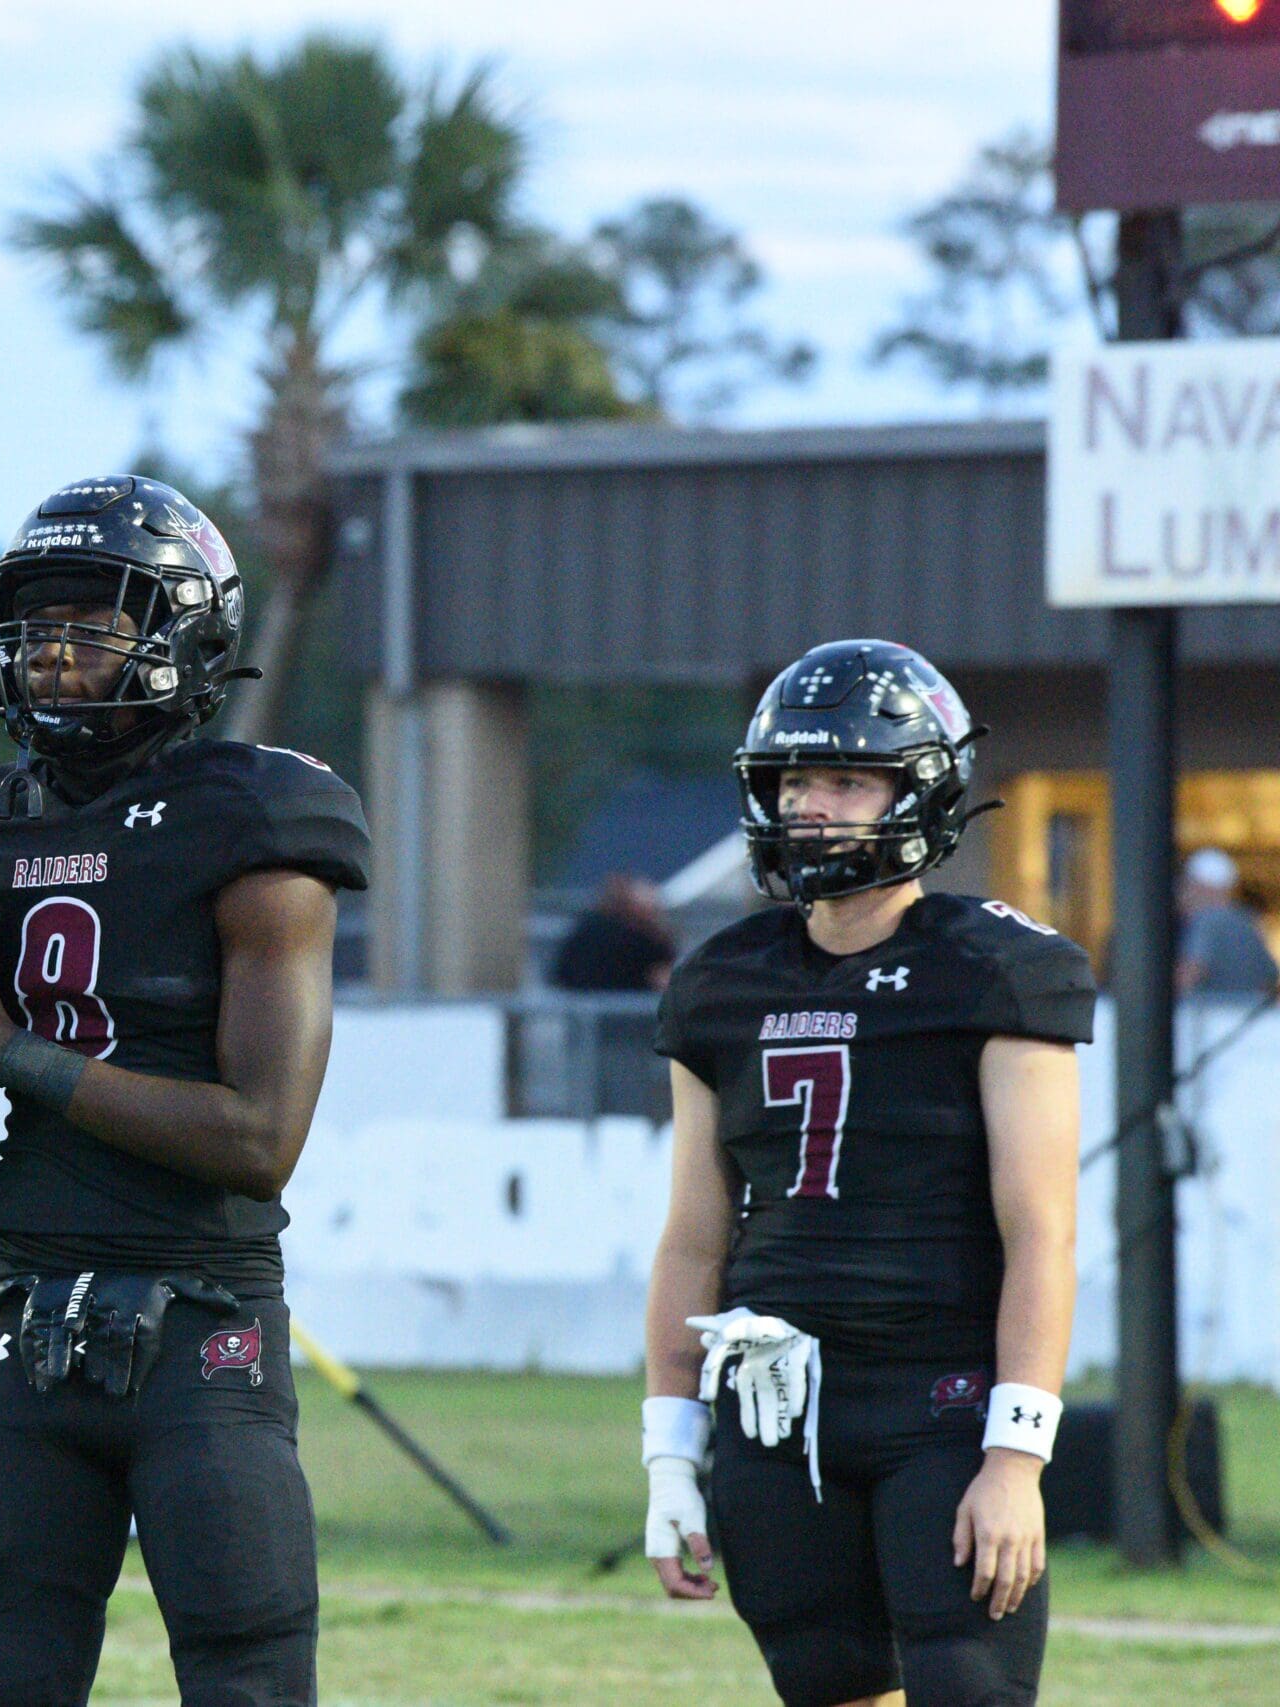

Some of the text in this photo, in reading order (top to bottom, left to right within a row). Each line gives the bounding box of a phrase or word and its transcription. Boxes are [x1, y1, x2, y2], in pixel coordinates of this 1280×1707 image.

[1102, 494, 1280, 576] LUM
[775, 729, 829, 744] Riddell
[12, 852, 108, 888] RAIDERS
[14, 896, 118, 1060] 8
[759, 1011, 858, 1040] RAIDERS
[762, 1044, 851, 1199] 7
